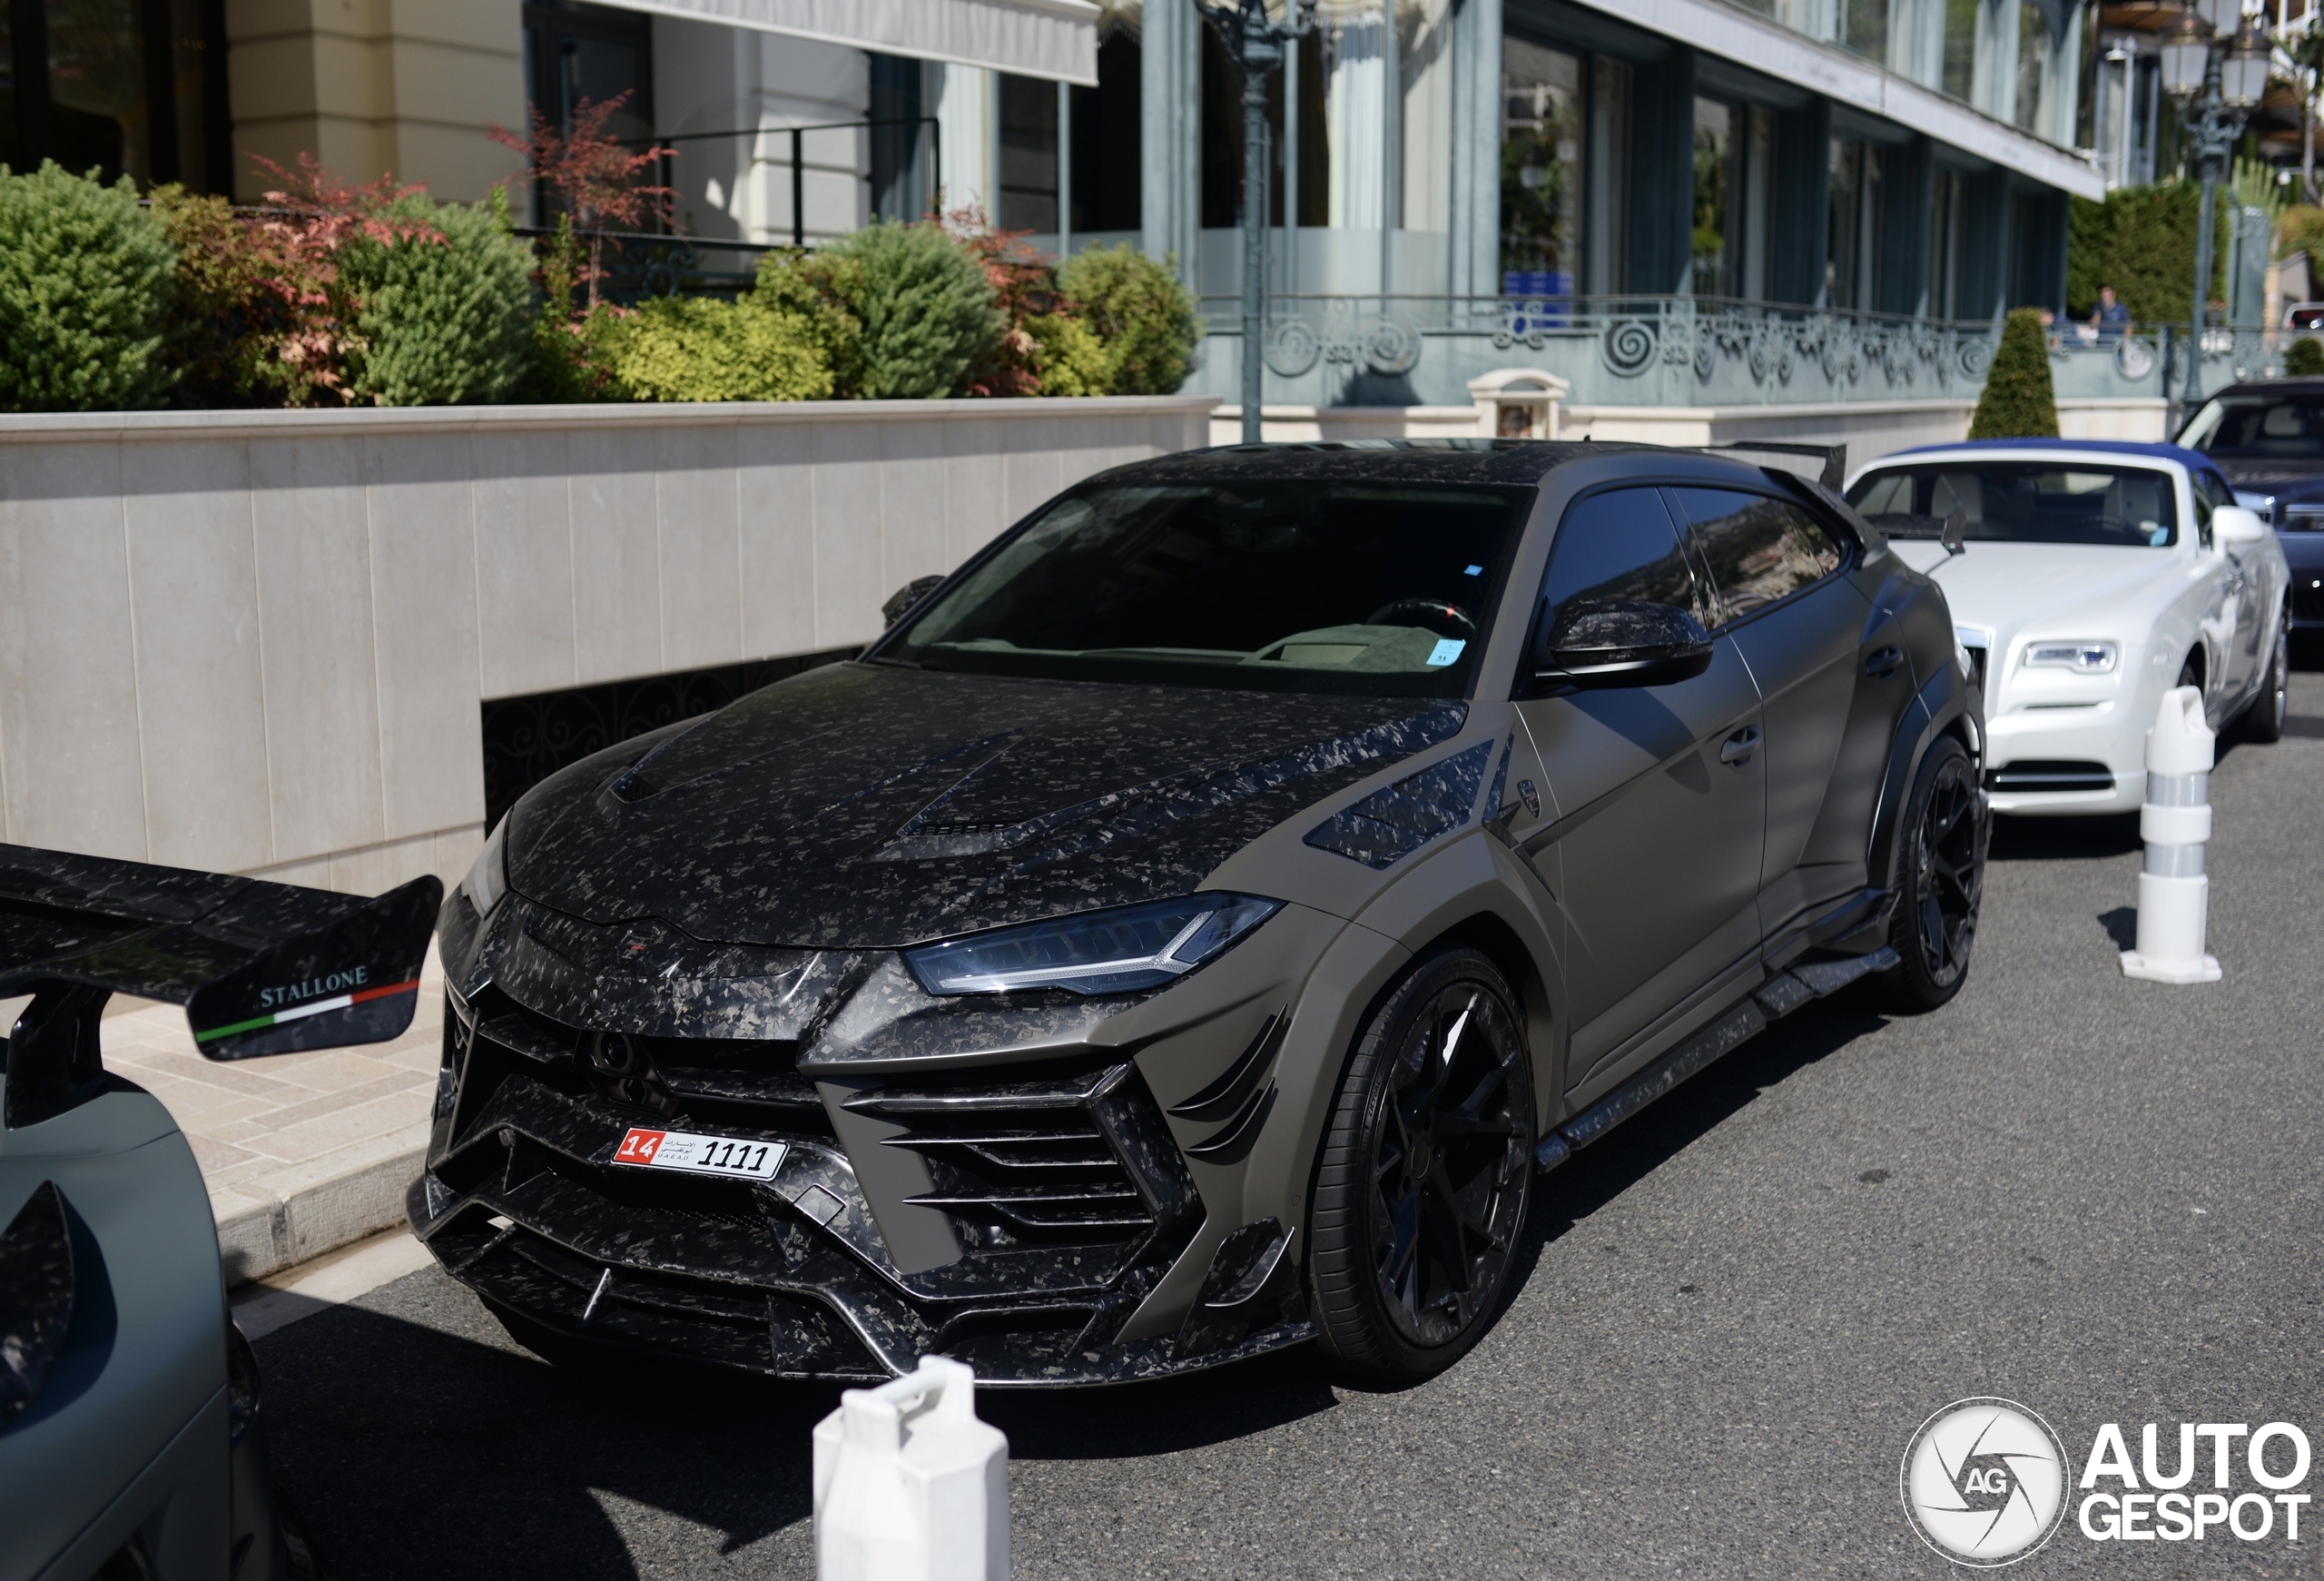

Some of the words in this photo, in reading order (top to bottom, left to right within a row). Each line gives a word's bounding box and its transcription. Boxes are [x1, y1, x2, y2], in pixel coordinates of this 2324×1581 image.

[260, 965, 369, 1008] STALLONE
[621, 1135, 658, 1158] 14
[697, 1141, 769, 1171] 1111
